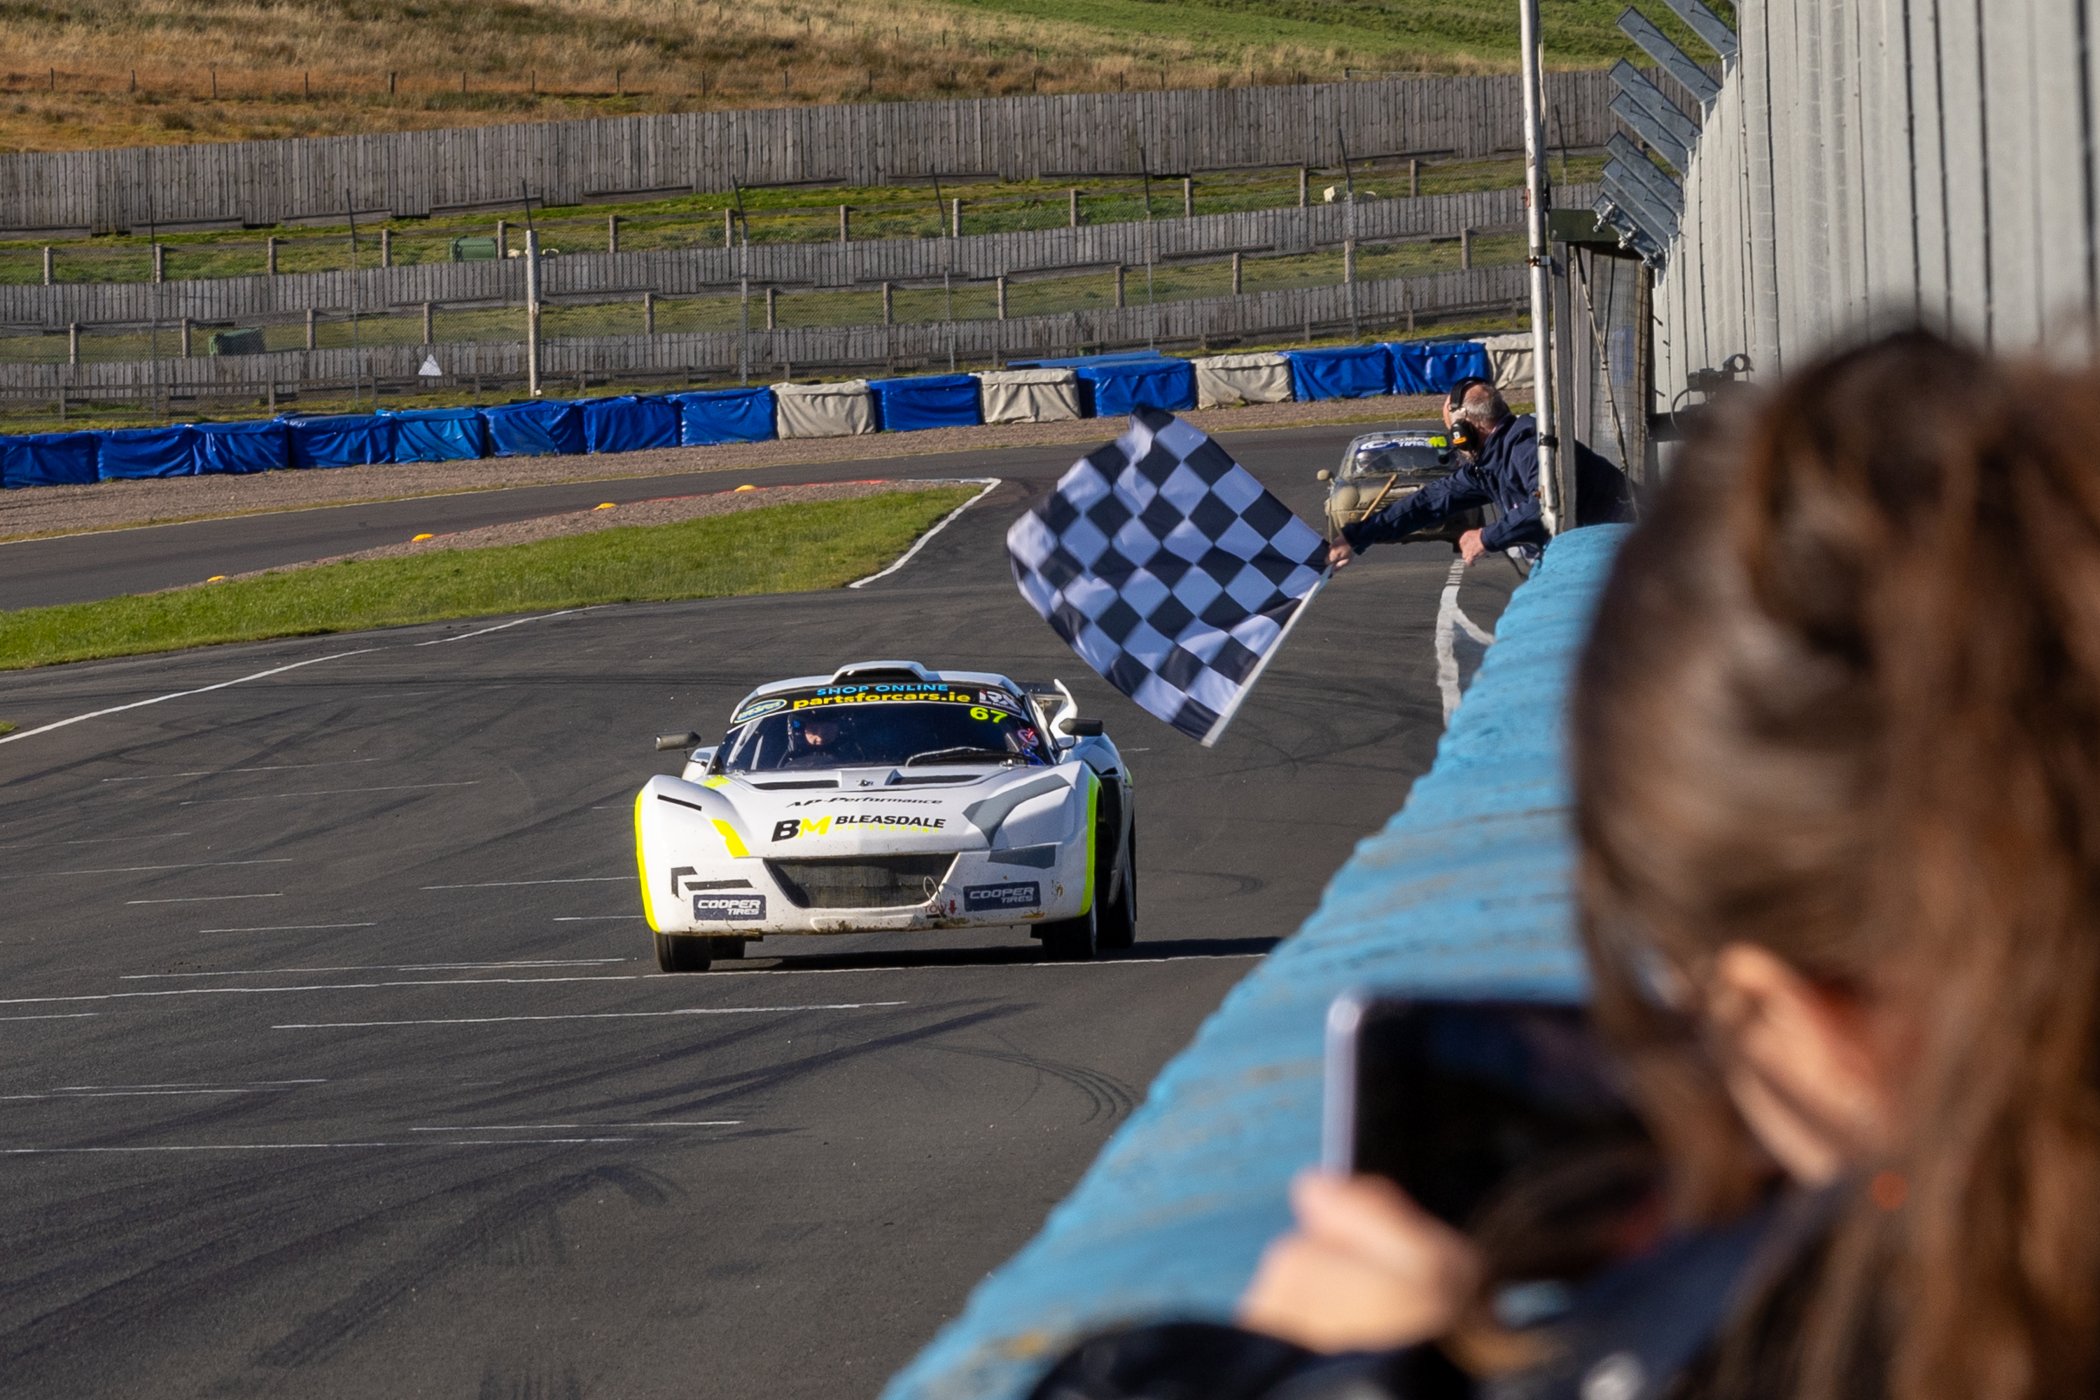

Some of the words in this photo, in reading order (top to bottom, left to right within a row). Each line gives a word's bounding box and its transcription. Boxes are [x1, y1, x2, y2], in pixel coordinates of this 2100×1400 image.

[816, 685, 869, 696] SHOP
[875, 684, 949, 692] ONLINE
[792, 691, 971, 710] partsforcars.ie
[969, 706, 1008, 724] 67
[771, 816, 832, 842] BM
[835, 815, 946, 828] BLEASDALE
[969, 887, 1035, 899] COOPER
[697, 899, 761, 909] COOPER
[1000, 895, 1034, 904] TIRES
